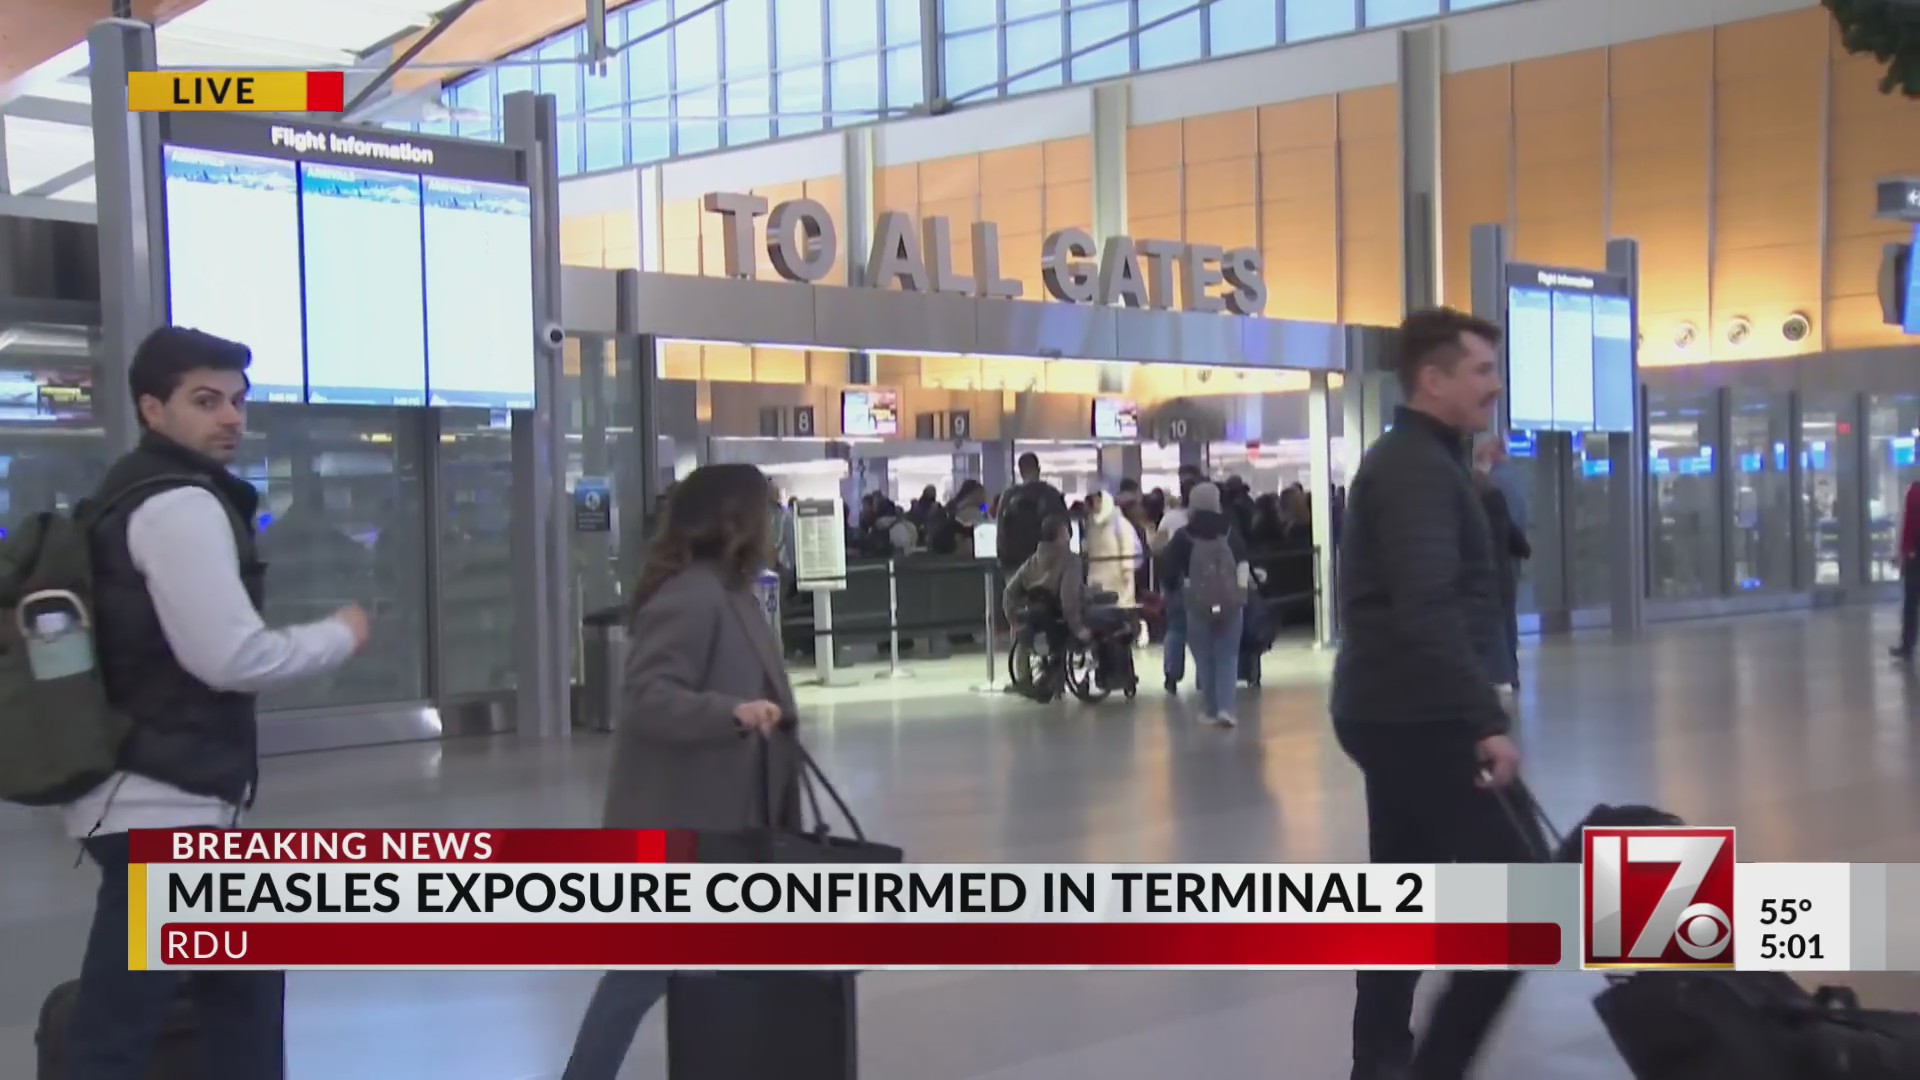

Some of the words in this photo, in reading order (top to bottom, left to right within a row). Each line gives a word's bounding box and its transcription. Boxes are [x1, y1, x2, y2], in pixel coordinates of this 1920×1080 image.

[271, 126, 326, 153] Flight
[330, 133, 434, 165] Information
[704, 192, 836, 282] TO
[865, 212, 1023, 298] ALL
[1042, 226, 1268, 317] GATES
[799, 411, 810, 433] 8
[954, 412, 966, 435] 9
[1170, 418, 1188, 438] 10
